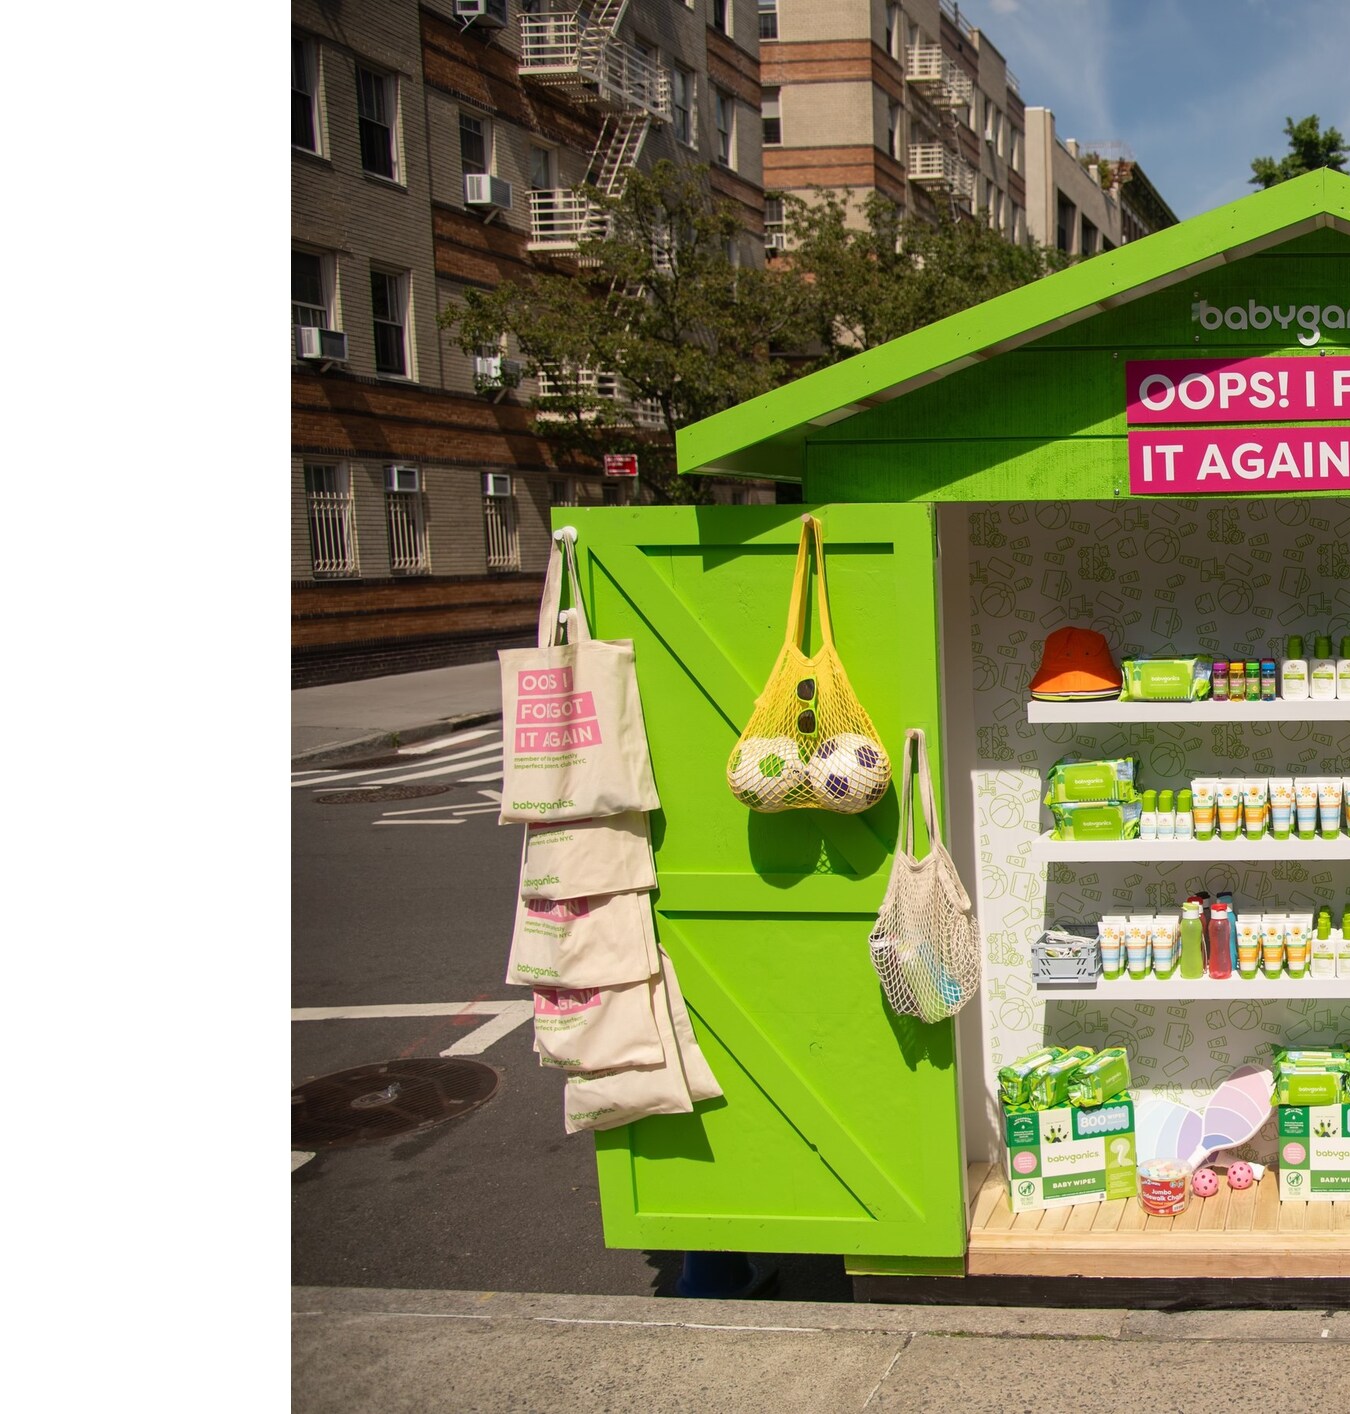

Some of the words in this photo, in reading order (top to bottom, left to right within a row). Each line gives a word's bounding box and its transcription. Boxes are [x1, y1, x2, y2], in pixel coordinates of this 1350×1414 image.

[1139, 370, 1289, 411] OOPS!
[1305, 370, 1316, 407] I
[1142, 444, 1184, 482] IT
[1197, 440, 1350, 481] AGAIN
[522, 674, 558, 691] OOS
[520, 732, 539, 748] IT
[542, 726, 593, 747] AGAIN
[530, 838, 546, 846] arent
[1080, 1114, 1107, 1128] 800
[1108, 1112, 1126, 1120] WIPES
[1048, 1150, 1100, 1164] babyganics
[1052, 1180, 1073, 1189] BABY
[1074, 1178, 1097, 1186] WIPES
[1320, 1176, 1339, 1184] BABY
